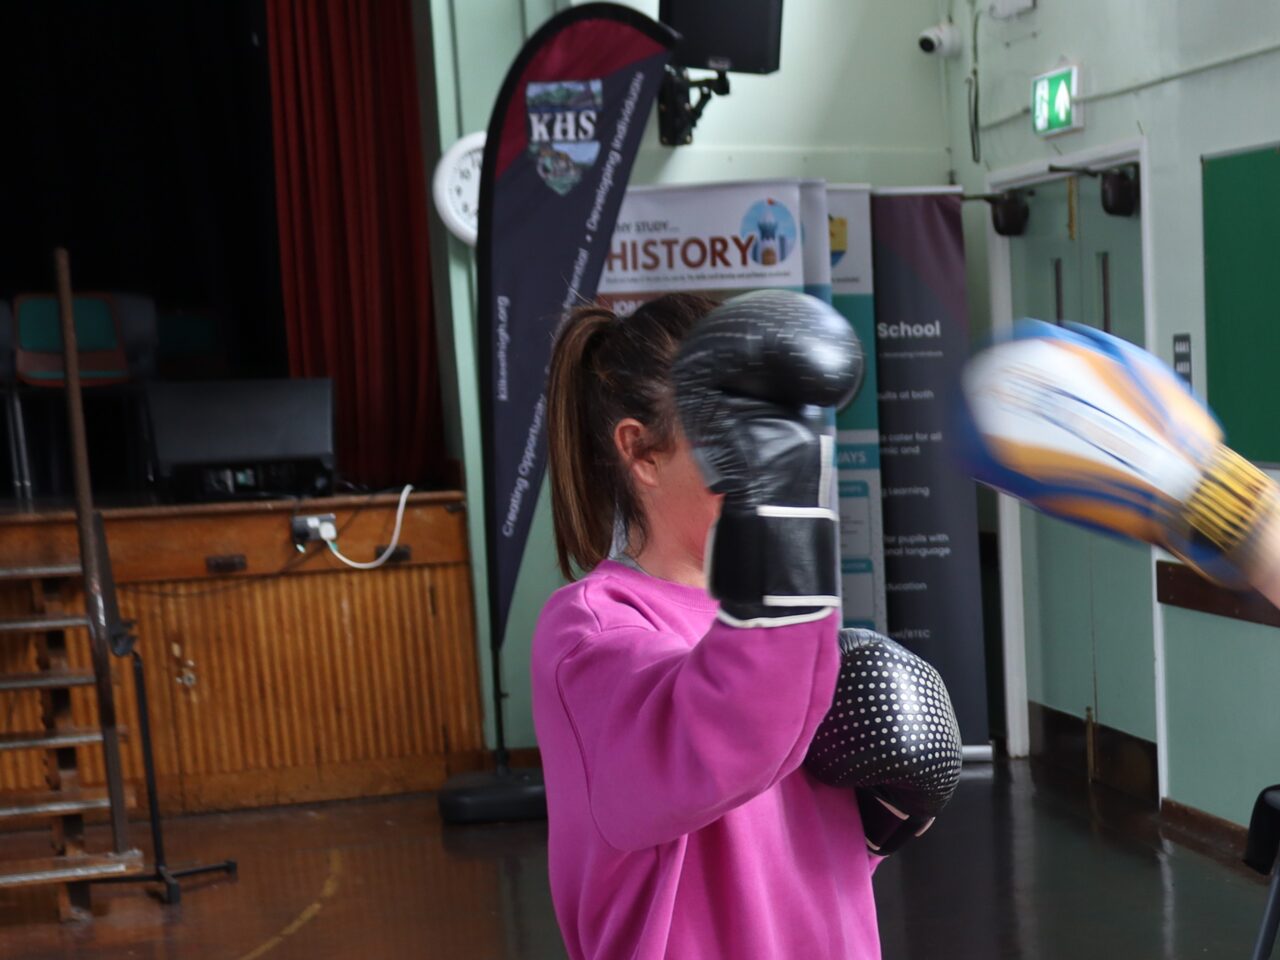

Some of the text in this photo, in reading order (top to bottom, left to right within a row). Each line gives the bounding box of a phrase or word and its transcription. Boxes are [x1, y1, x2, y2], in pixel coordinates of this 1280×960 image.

[529, 110, 597, 142] KHS
[614, 221, 632, 233] HY
[606, 234, 755, 272] HISTORY
[502, 477, 530, 538] Creating
[518, 393, 548, 477] Opportunity
[585, 150, 622, 232] Developing
[611, 70, 645, 149] Individuals
[877, 319, 941, 338] School
[911, 389, 935, 399] both
[888, 433, 913, 441] cater
[915, 431, 929, 441] for
[929, 431, 943, 441] all
[900, 446, 920, 455] and
[888, 486, 930, 498] Learning
[897, 533, 928, 544] pupils
[928, 532, 949, 542] with
[904, 546, 951, 558] language
